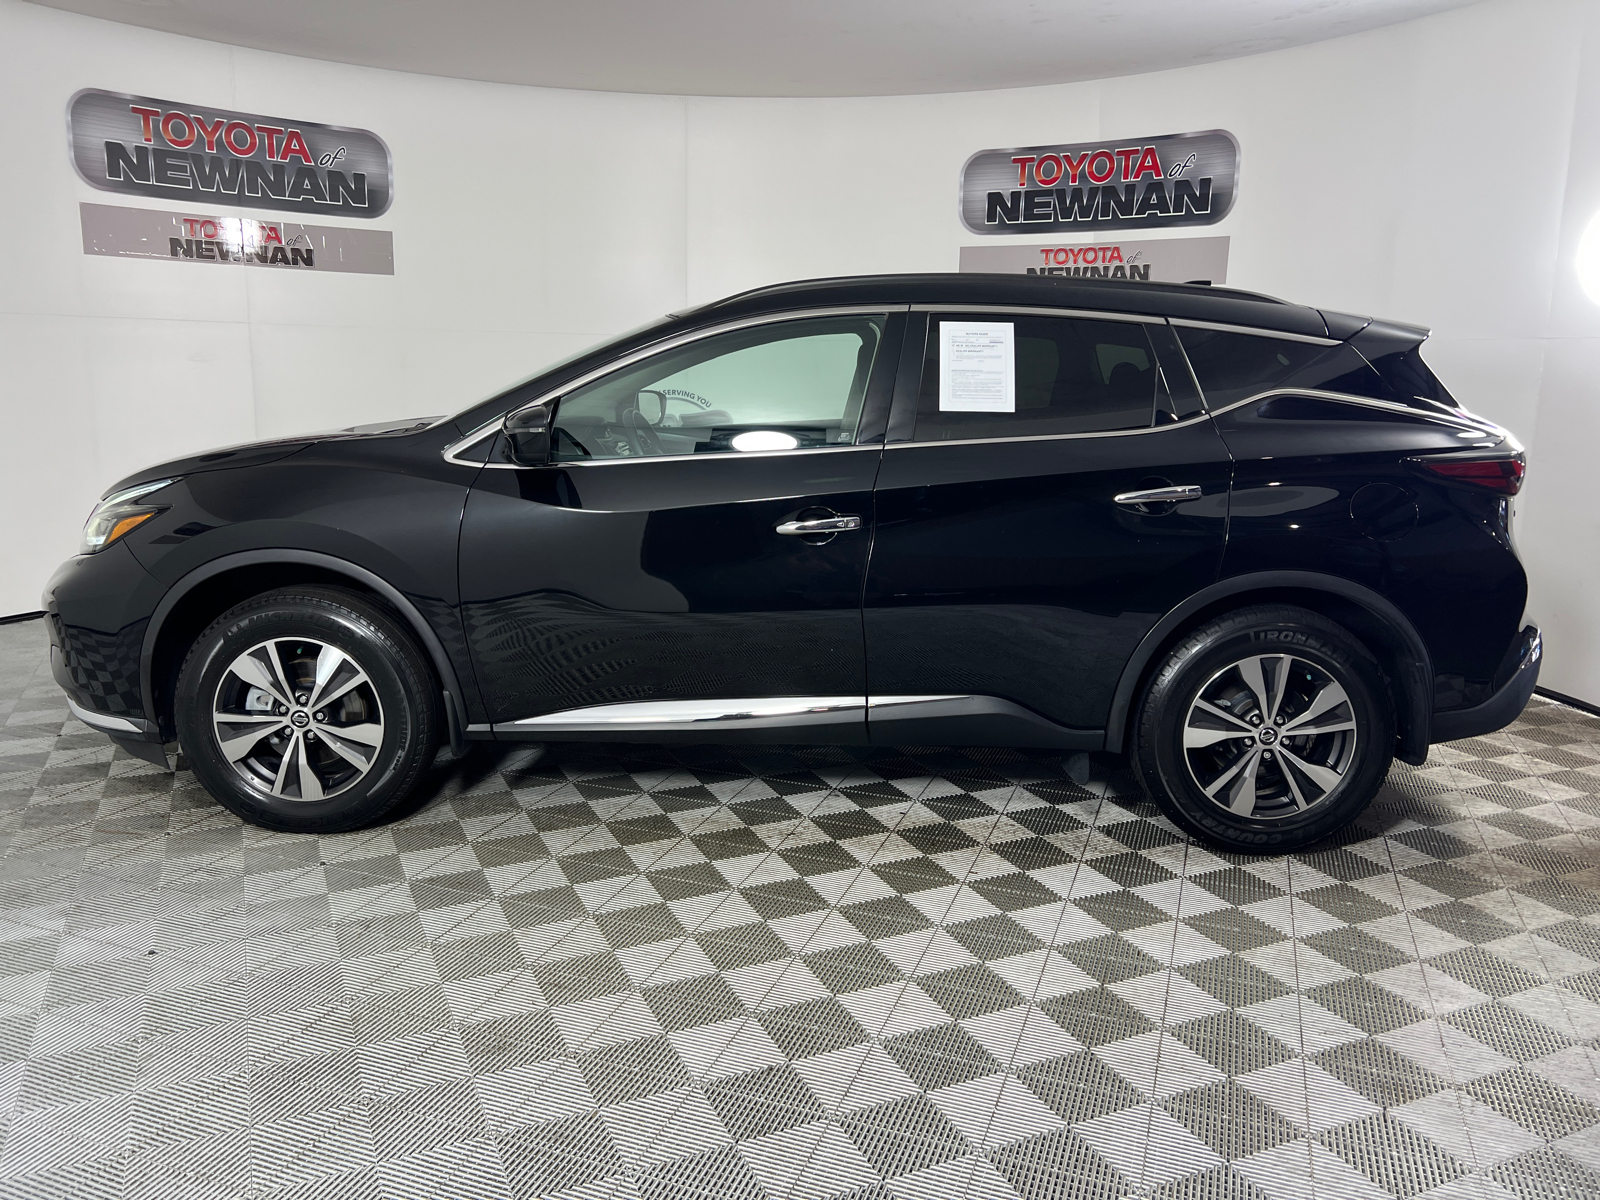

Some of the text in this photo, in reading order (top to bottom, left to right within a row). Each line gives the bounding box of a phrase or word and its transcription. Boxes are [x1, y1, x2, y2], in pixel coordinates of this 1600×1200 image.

[130, 104, 346, 168] TOYOTA of
[104, 141, 369, 207] NEWNAN
[1012, 146, 1196, 188] TOYOTA of
[985, 177, 1212, 225] NEWNAN
[183, 218, 302, 247] TOTA of
[1040, 246, 1142, 265] TOYOTA of
[663, 389, 712, 408] SERVING YOU
[1259, 630, 1349, 663] IRONMAN
[1189, 808, 1284, 845] COUNTRY
